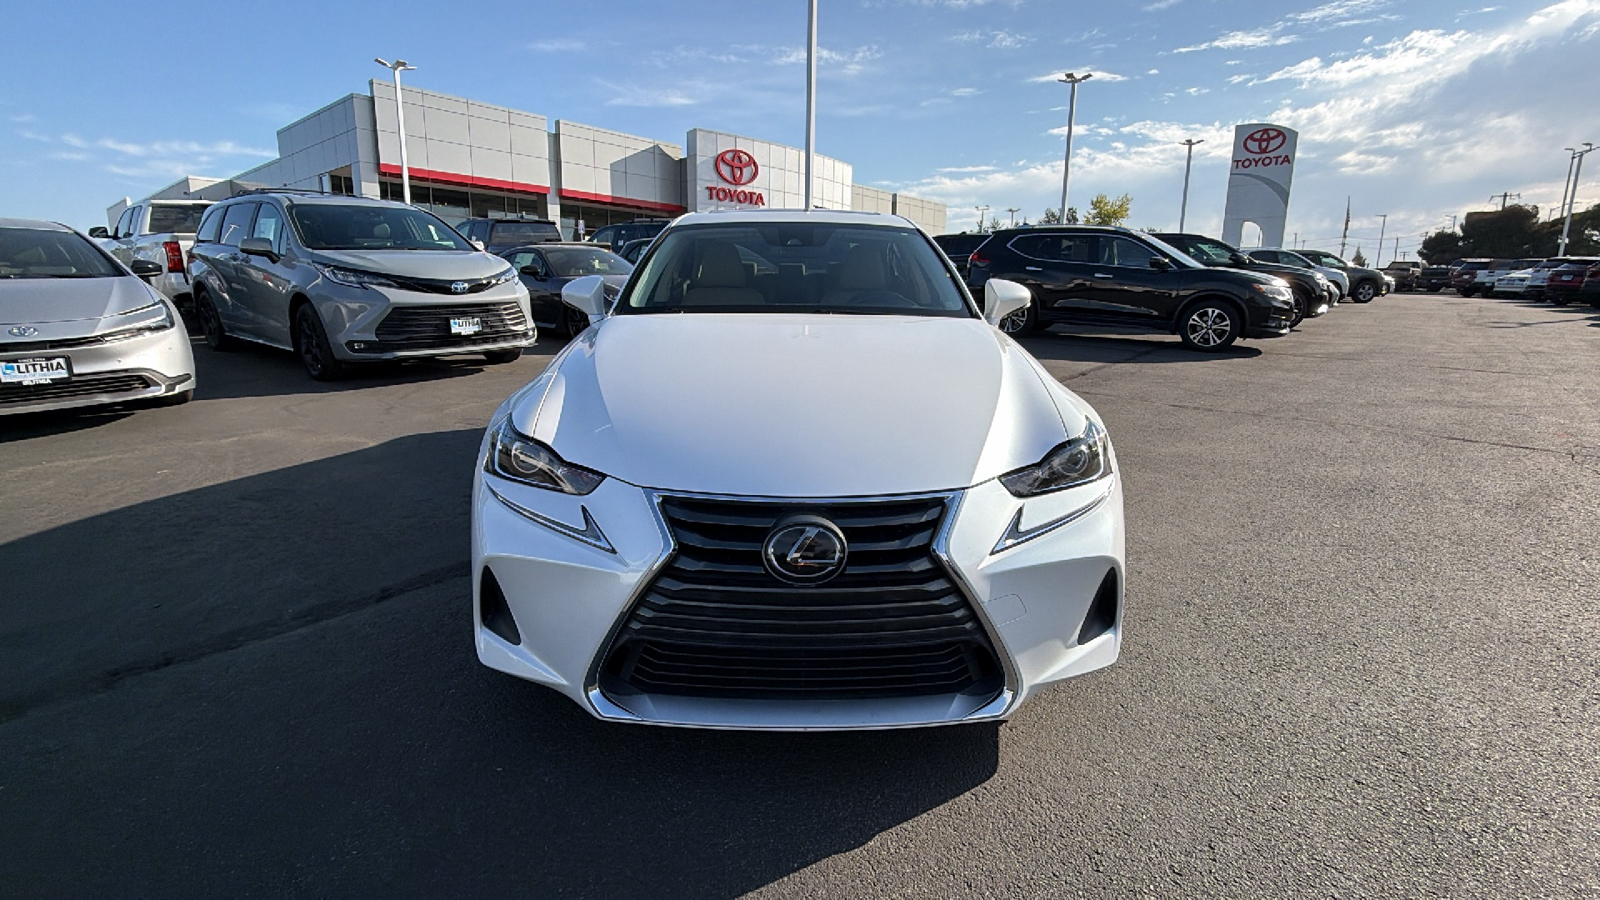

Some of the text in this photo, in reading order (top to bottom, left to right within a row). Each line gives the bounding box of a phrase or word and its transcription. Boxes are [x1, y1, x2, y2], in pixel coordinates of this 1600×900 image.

[1233, 154, 1291, 169] TOYOTA
[706, 186, 765, 206] TOYOTA
[16, 361, 66, 374] LITHIA
